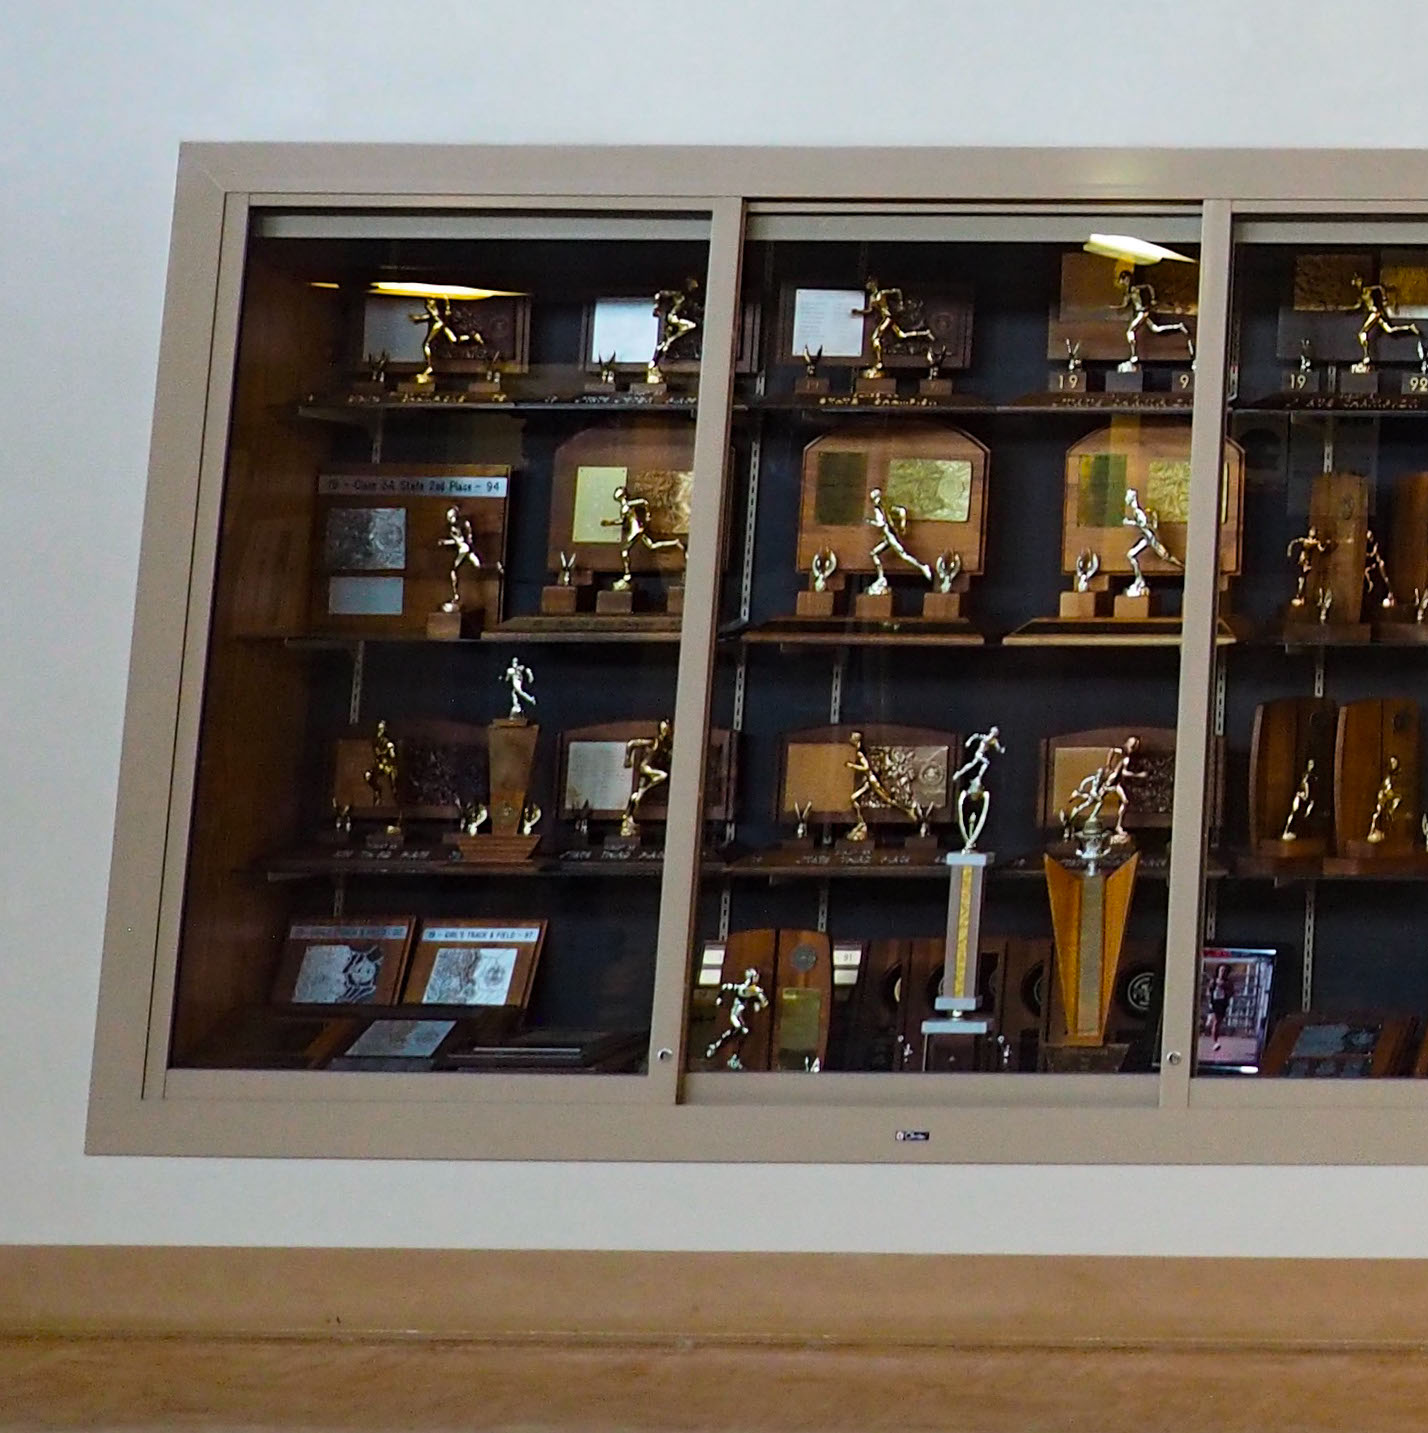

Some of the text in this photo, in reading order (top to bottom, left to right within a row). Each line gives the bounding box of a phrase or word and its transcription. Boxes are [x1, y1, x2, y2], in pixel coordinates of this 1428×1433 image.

[1059, 374, 1079, 389] 19
[1290, 373, 1307, 389] 19
[1409, 376, 1428, 392] 92
